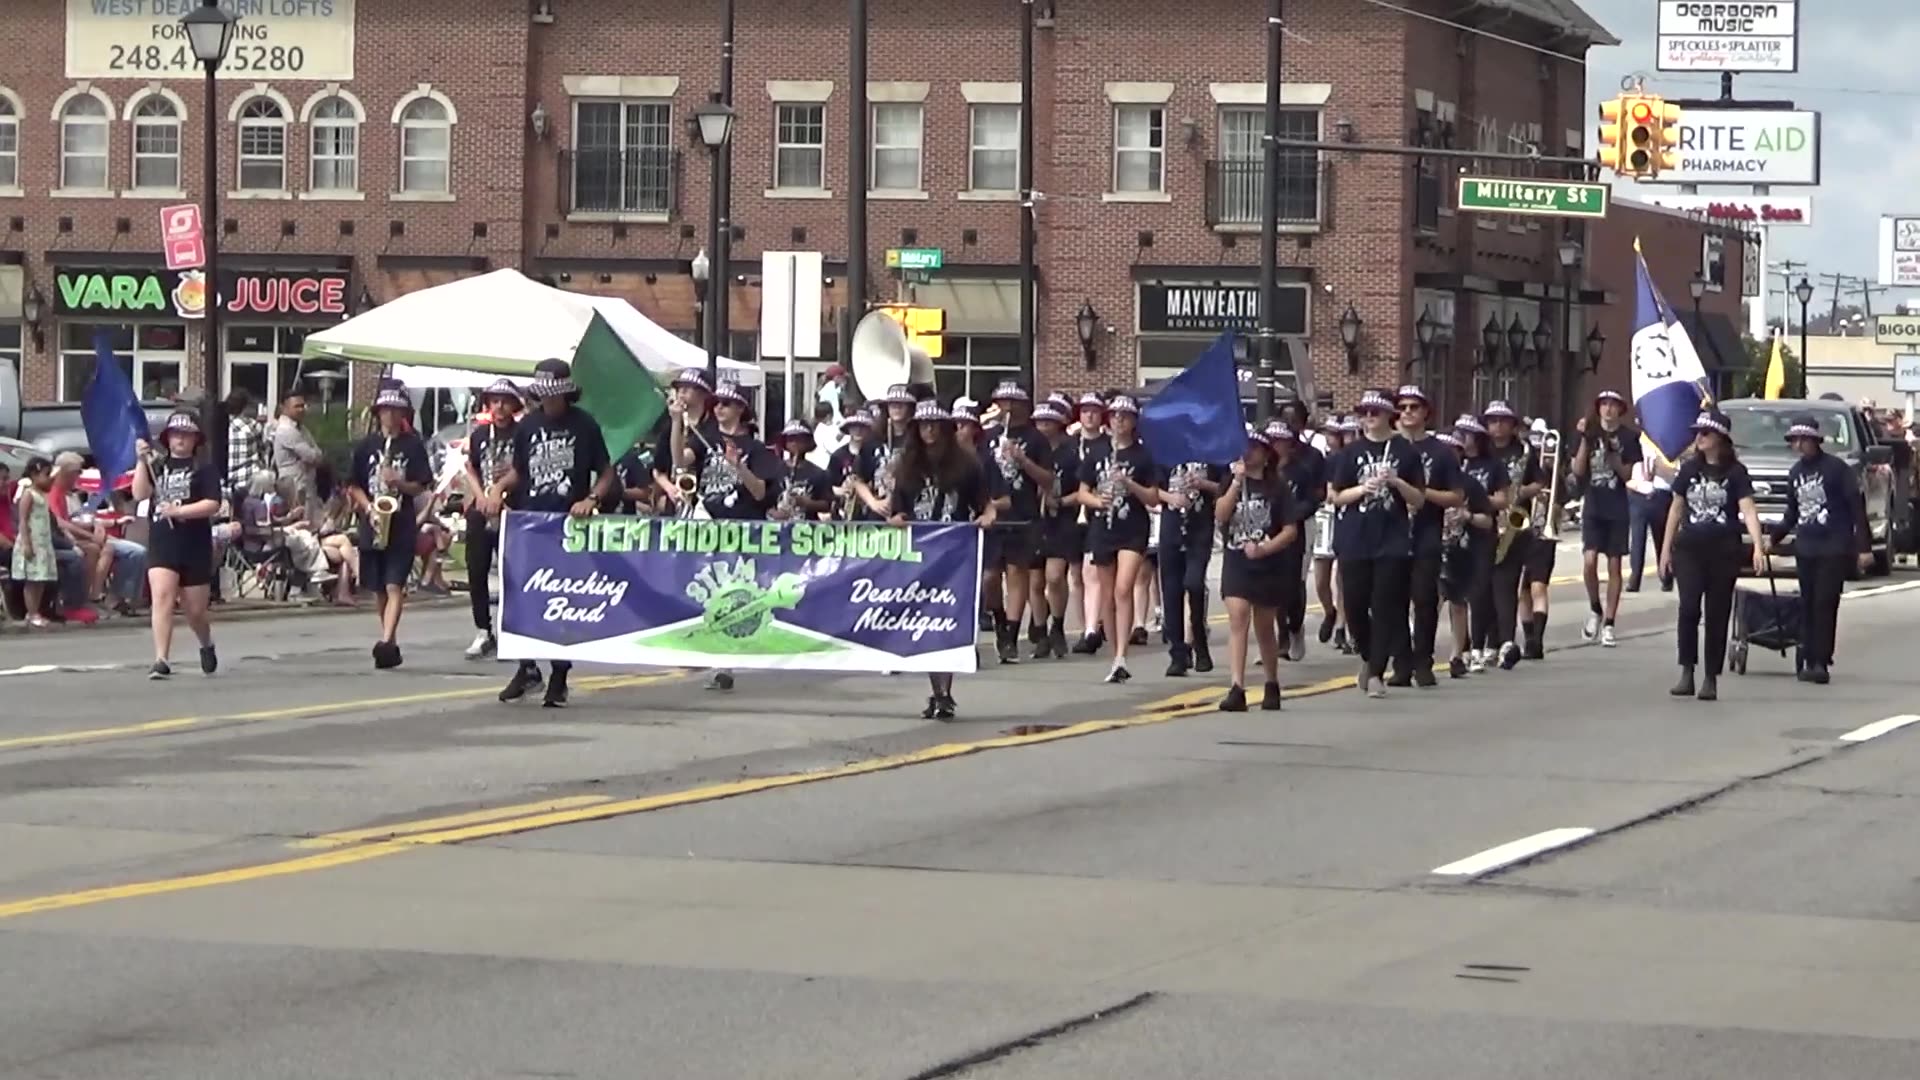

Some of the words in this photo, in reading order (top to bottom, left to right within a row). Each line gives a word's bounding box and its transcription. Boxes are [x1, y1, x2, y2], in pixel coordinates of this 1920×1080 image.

[91, 0, 144, 17] WEST
[270, 0, 333, 17] LOFTS
[152, 24, 187, 40] FOR
[109, 45, 305, 72] 248.4.5280
[1668, 40, 1720, 51] SPECKLES
[1728, 40, 1781, 52] SPLATTER
[1679, 125, 1745, 151] RITE
[1754, 127, 1806, 152] AID
[1682, 158, 1767, 172] PHARMACY
[1477, 182, 1556, 205] Military
[1566, 187, 1588, 204] St
[57, 274, 165, 310] VARA
[228, 277, 345, 312] JUICE
[1167, 289, 1261, 317] MAYWEATH
[1167, 319, 1215, 328] BOXING
[562, 516, 650, 552] STEM
[659, 518, 782, 554] MIDDLE
[791, 522, 922, 563] SCHOOL
[523, 568, 629, 606] Marching
[686, 555, 756, 603] STEM
[850, 578, 957, 606] Dearborn,
[543, 597, 607, 622] Band
[853, 606, 957, 641] Michigan
